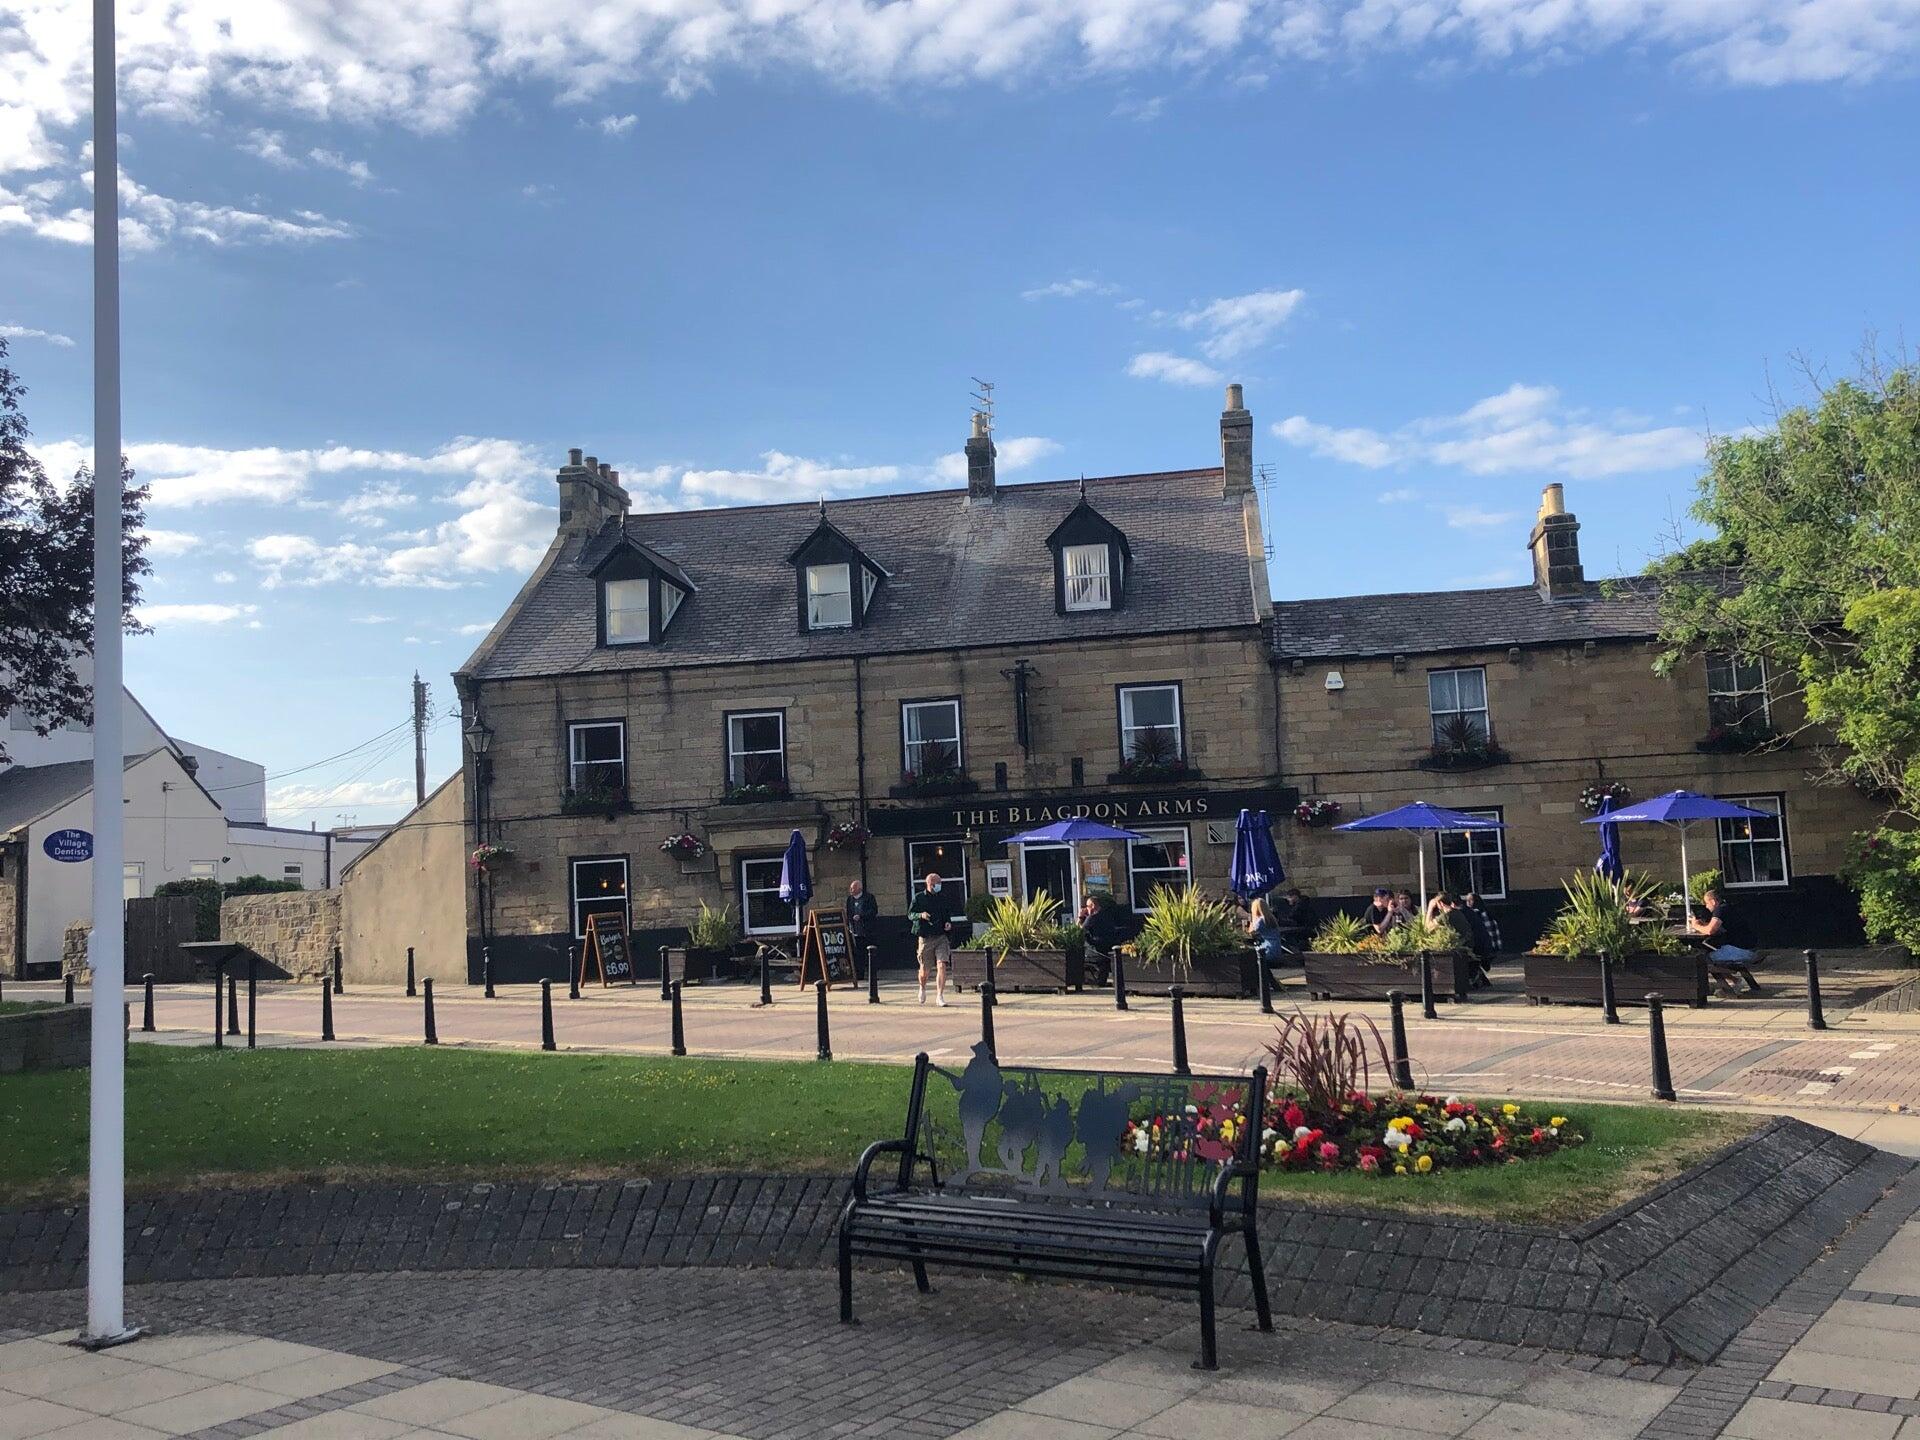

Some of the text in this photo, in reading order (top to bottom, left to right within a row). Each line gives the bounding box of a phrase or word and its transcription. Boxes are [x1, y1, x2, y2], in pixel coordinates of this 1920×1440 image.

[952, 798, 1208, 826] THE BLAGDON ARMS
[66, 830, 80, 839] The
[58, 839, 87, 849] Village
[54, 847, 89, 856] Dentists
[606, 962, 629, 975] £6.99
